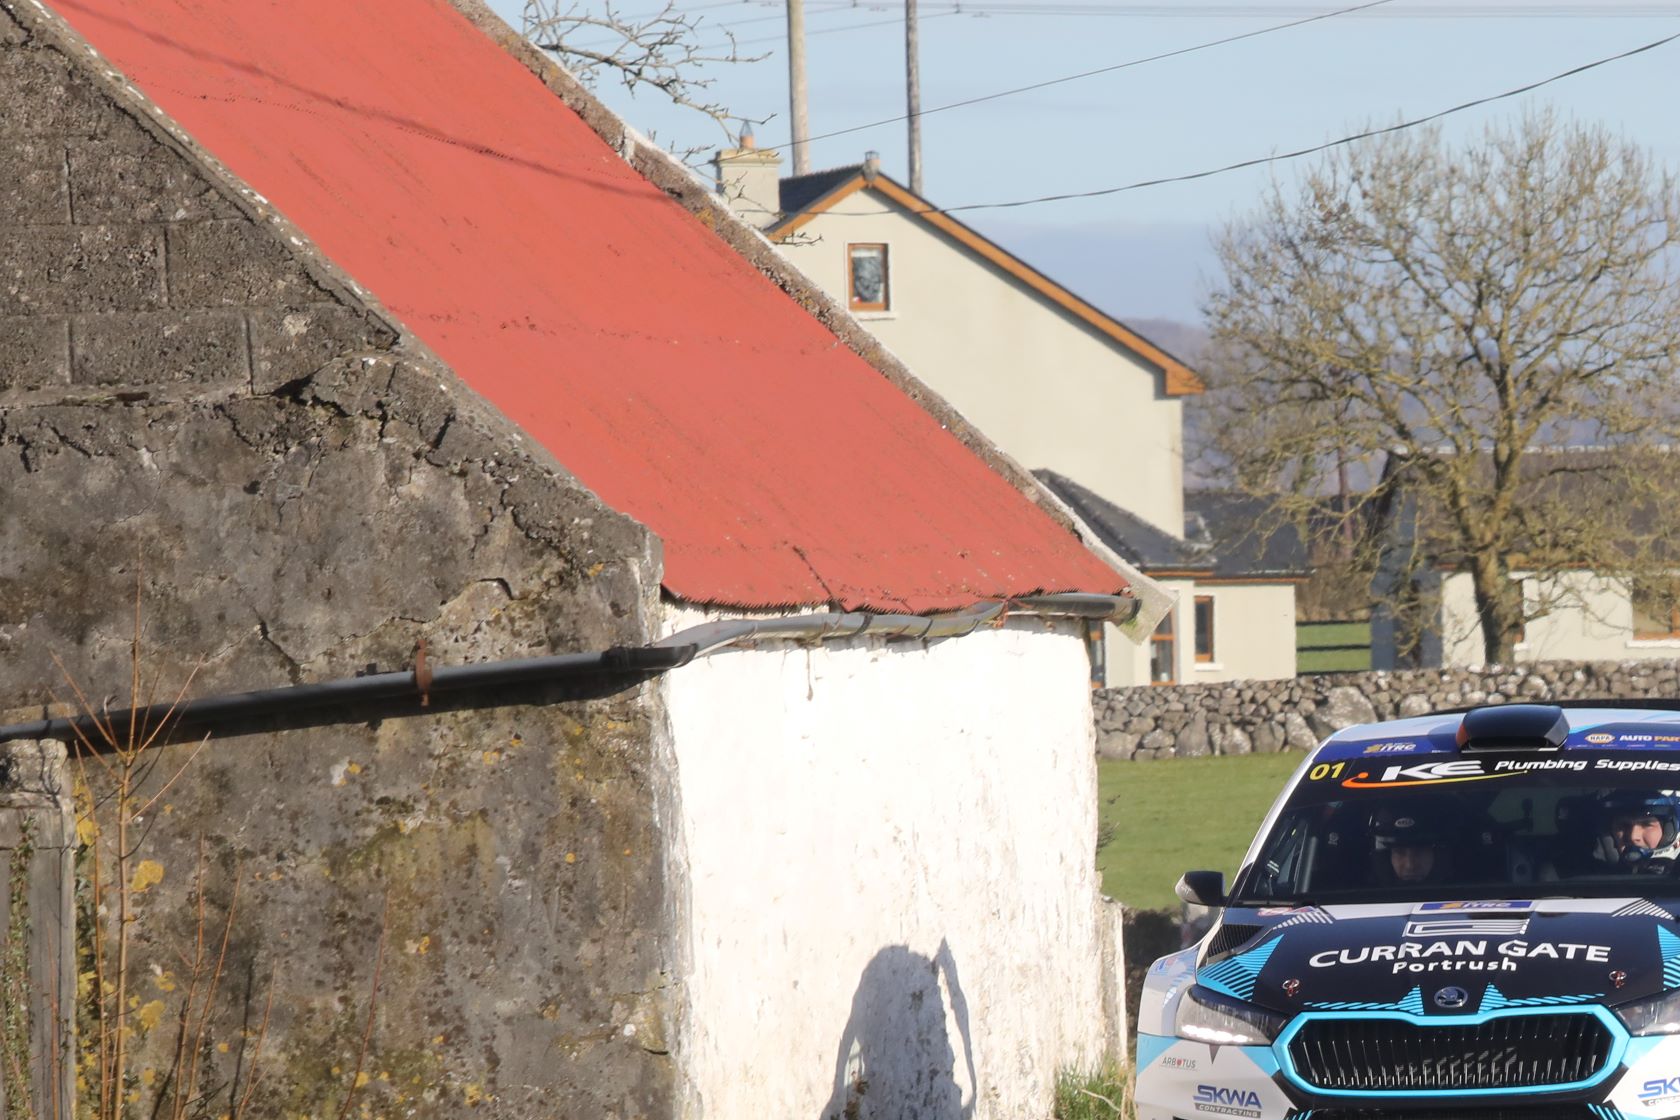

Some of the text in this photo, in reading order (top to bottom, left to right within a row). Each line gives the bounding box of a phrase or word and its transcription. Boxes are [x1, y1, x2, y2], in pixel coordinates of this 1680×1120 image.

[1619, 734, 1652, 742] AUTO
[1309, 761, 1345, 781] 01
[1380, 760, 1485, 782] KE
[1495, 759, 1587, 772] Plumbing
[1309, 939, 1612, 968] CURRAN GATE
[1391, 957, 1518, 974] Portrush
[1193, 1084, 1263, 1109] SKWA
[1198, 1104, 1259, 1118] CONTRACTING
